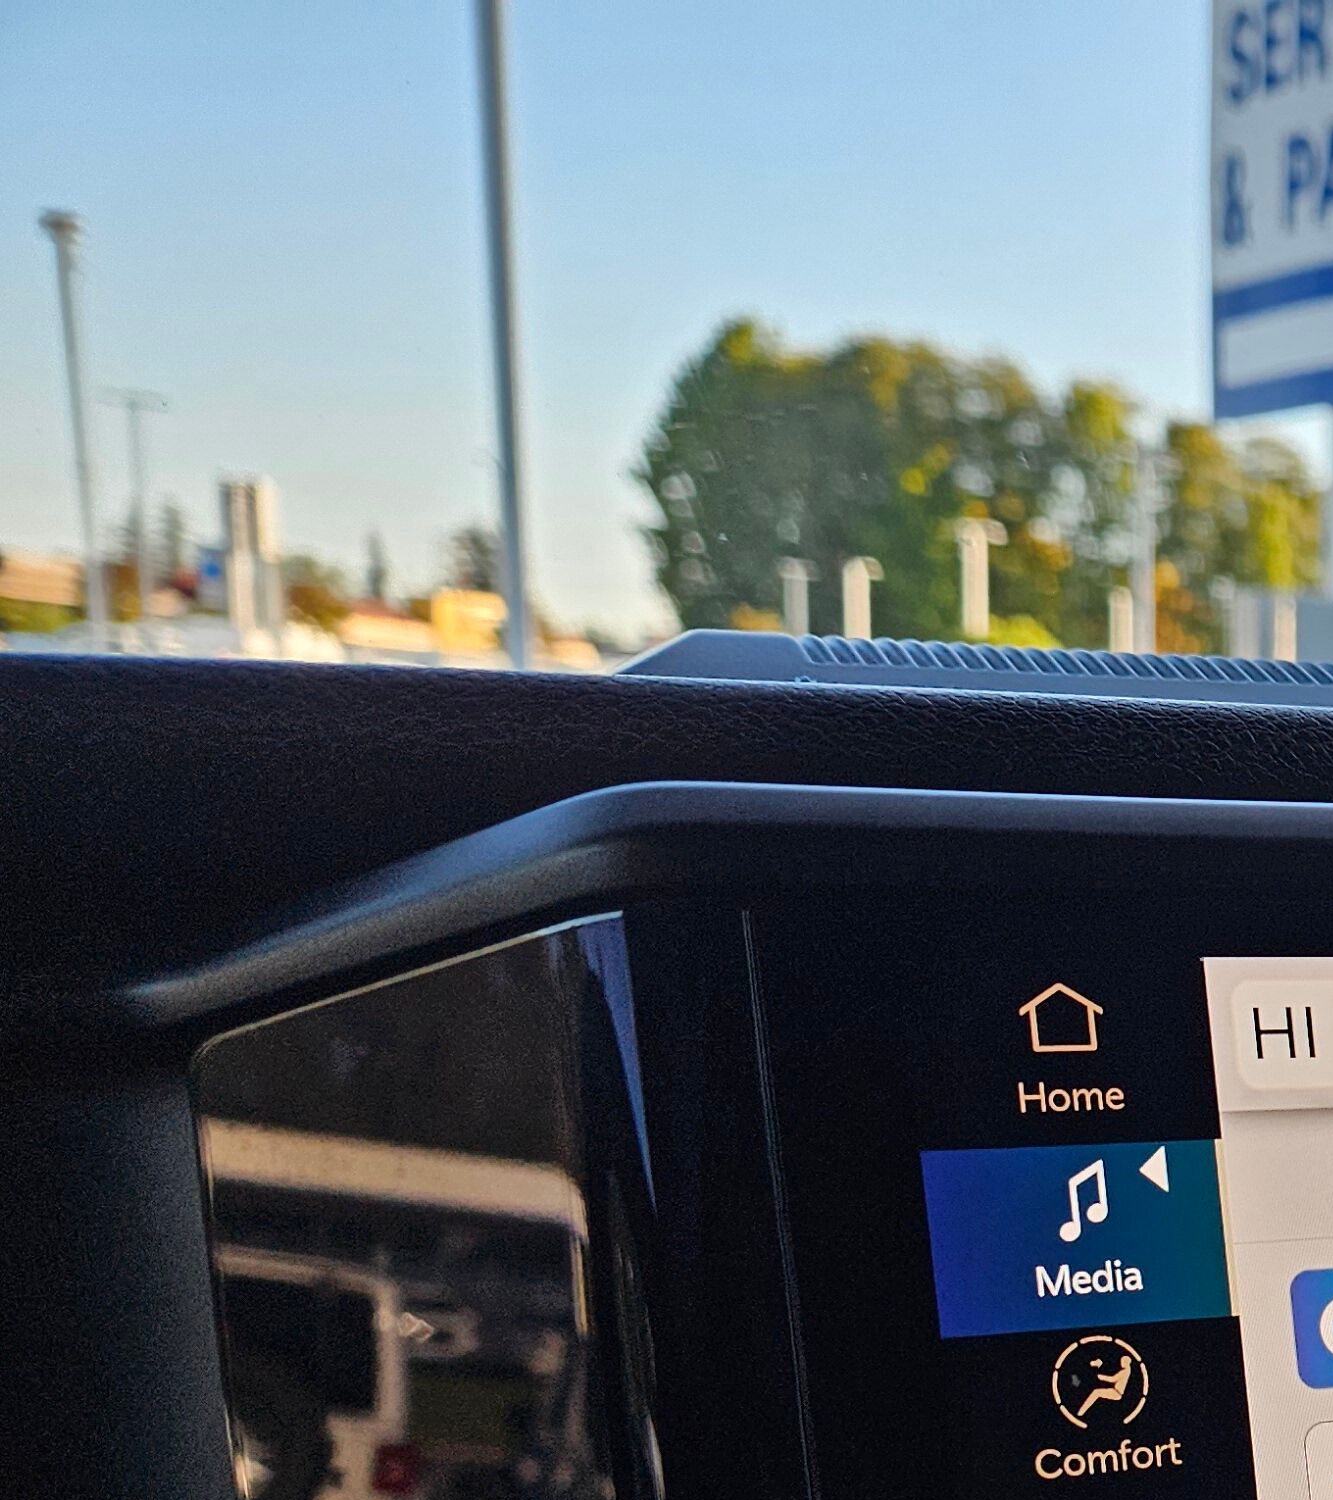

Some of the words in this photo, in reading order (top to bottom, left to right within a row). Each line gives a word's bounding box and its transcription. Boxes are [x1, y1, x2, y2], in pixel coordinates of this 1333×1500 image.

[1252, 1006, 1318, 1061] HI
[1018, 1082, 1124, 1114] Home
[1035, 1262, 1143, 1297] Media
[1035, 1437, 1183, 1480] Comfort
